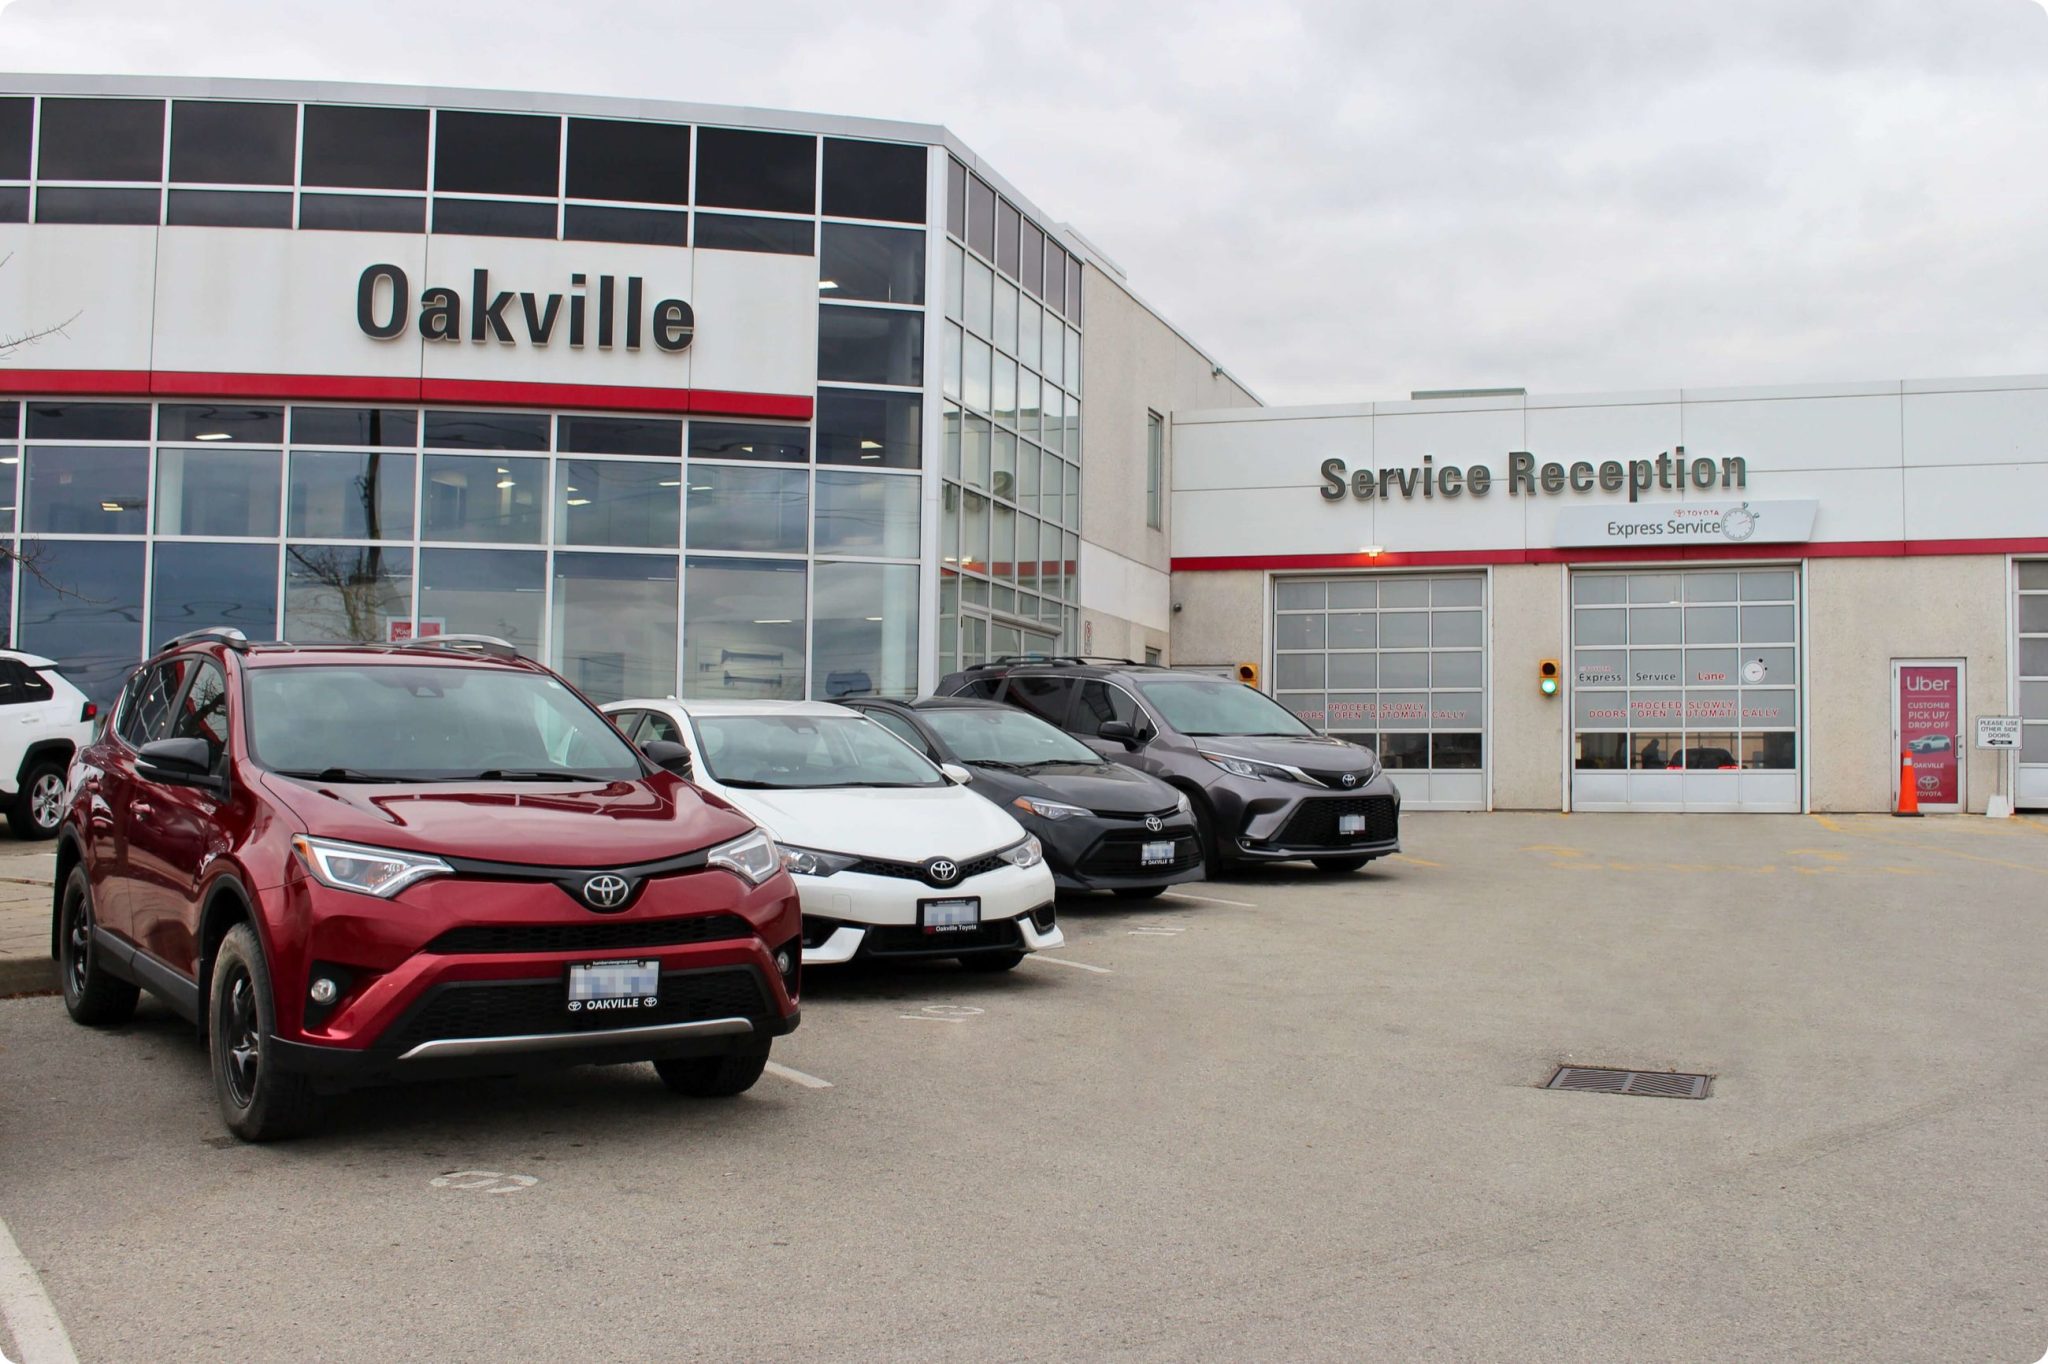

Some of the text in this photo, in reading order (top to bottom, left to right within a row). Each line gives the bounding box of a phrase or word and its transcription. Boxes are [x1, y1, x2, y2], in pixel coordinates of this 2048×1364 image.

[356, 263, 696, 352] Oakville
[1320, 446, 1747, 503] Service Reception
[1607, 519, 1721, 539] Express Service
[1579, 672, 1725, 684] Express Service Lane
[1906, 676, 1950, 691] Uber
[1328, 703, 1424, 711] PROCEED SLOWLY
[1630, 701, 1734, 709] PROCEED SLOWLY
[1334, 711, 1361, 719] OPEN
[1589, 710, 1627, 718] DOORS
[1637, 710, 1667, 718] OPEN
[1908, 711, 1950, 720] PICK UP/
[1908, 721, 1950, 729] DROP OFF
[959, 924, 977, 932] Toyota
[586, 998, 639, 1010] OAKVILLE
